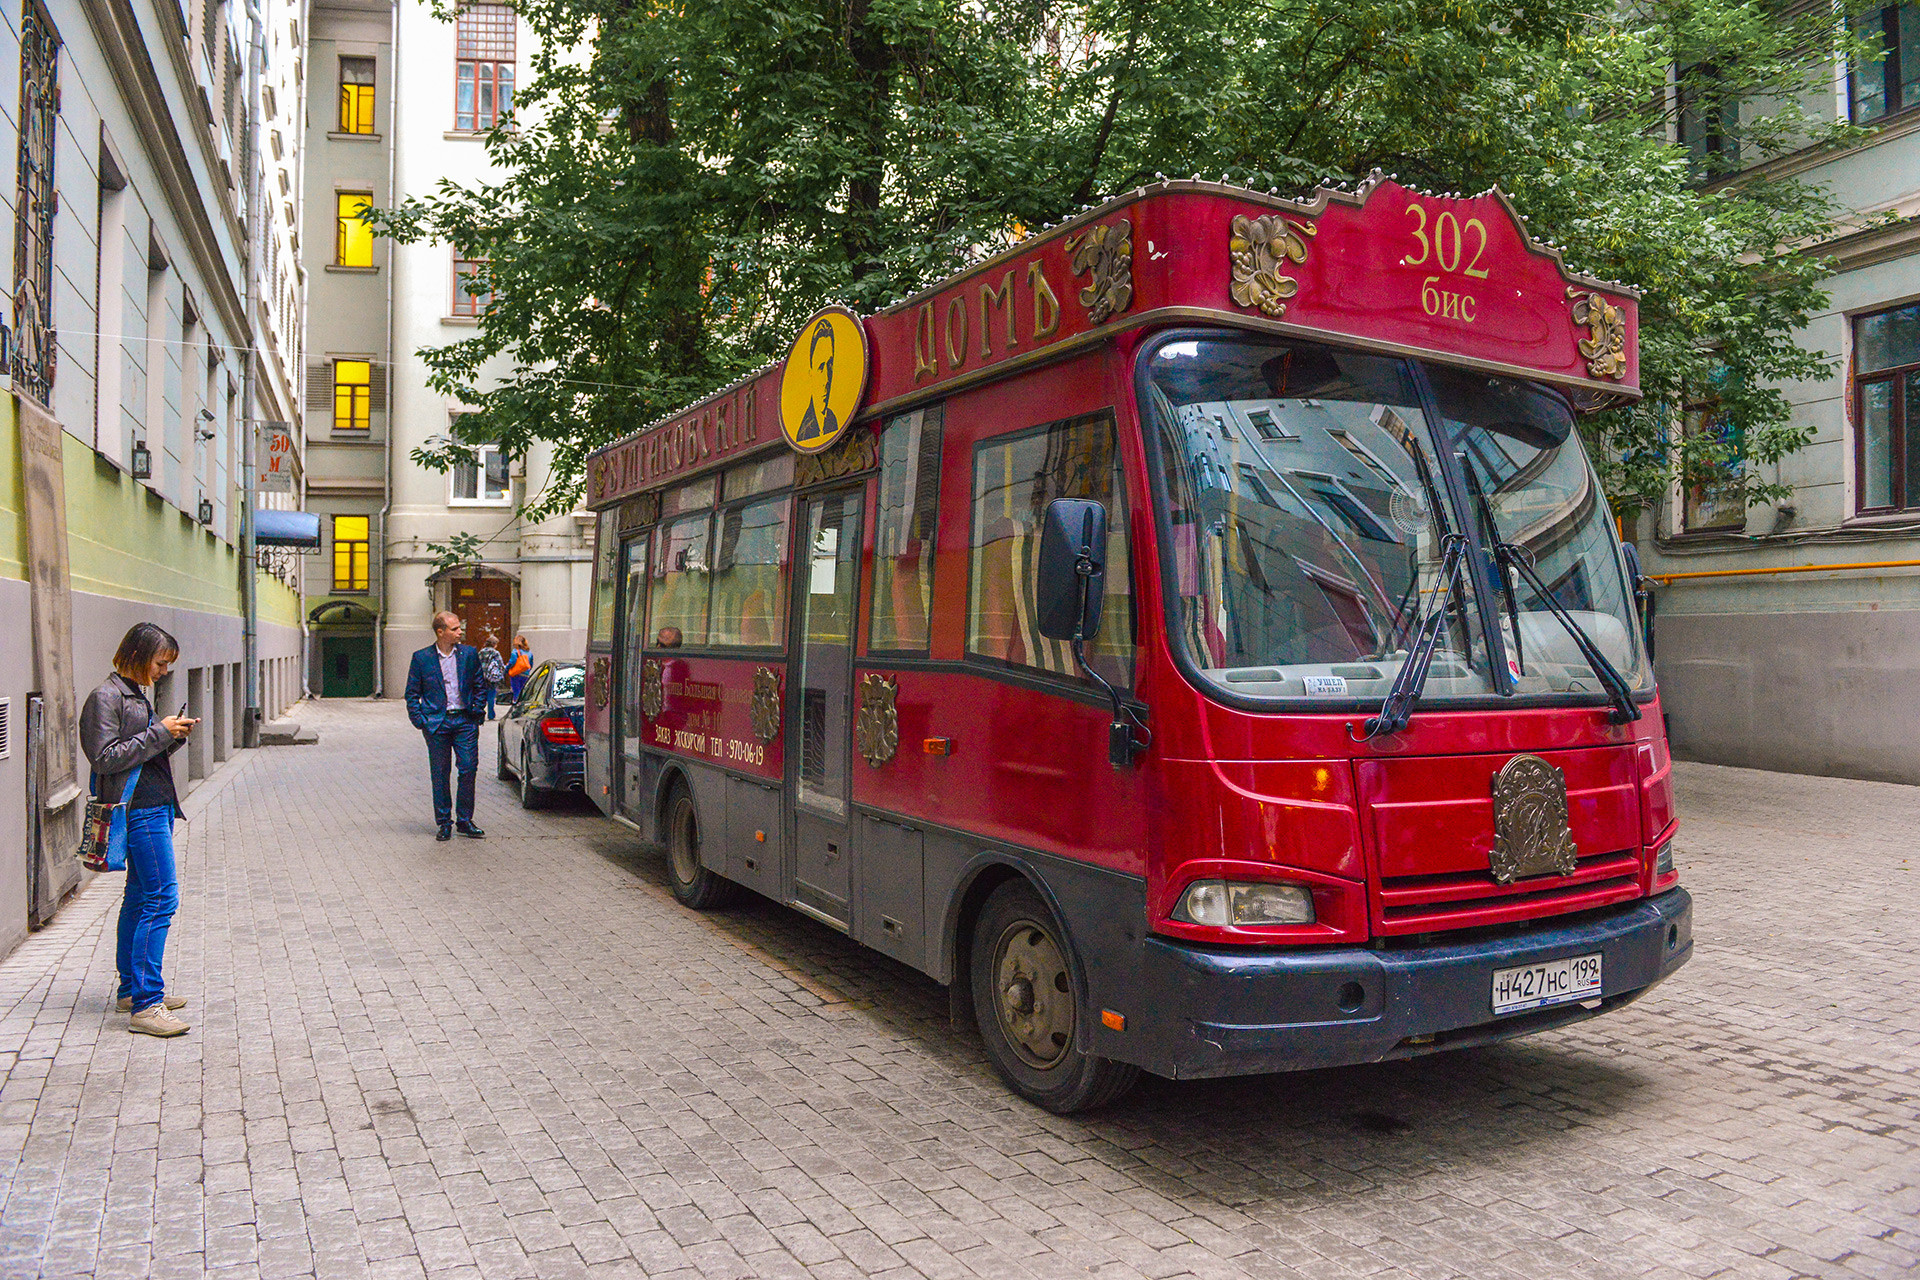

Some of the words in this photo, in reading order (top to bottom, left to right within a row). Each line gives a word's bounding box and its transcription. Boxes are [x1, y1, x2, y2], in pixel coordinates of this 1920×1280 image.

[1405, 203, 1490, 279] 302
[914, 258, 1061, 383] ДОМЪ
[1421, 276, 1476, 323] бис
[269, 434, 290, 453] 50
[1577, 979, 1590, 988] RUS
